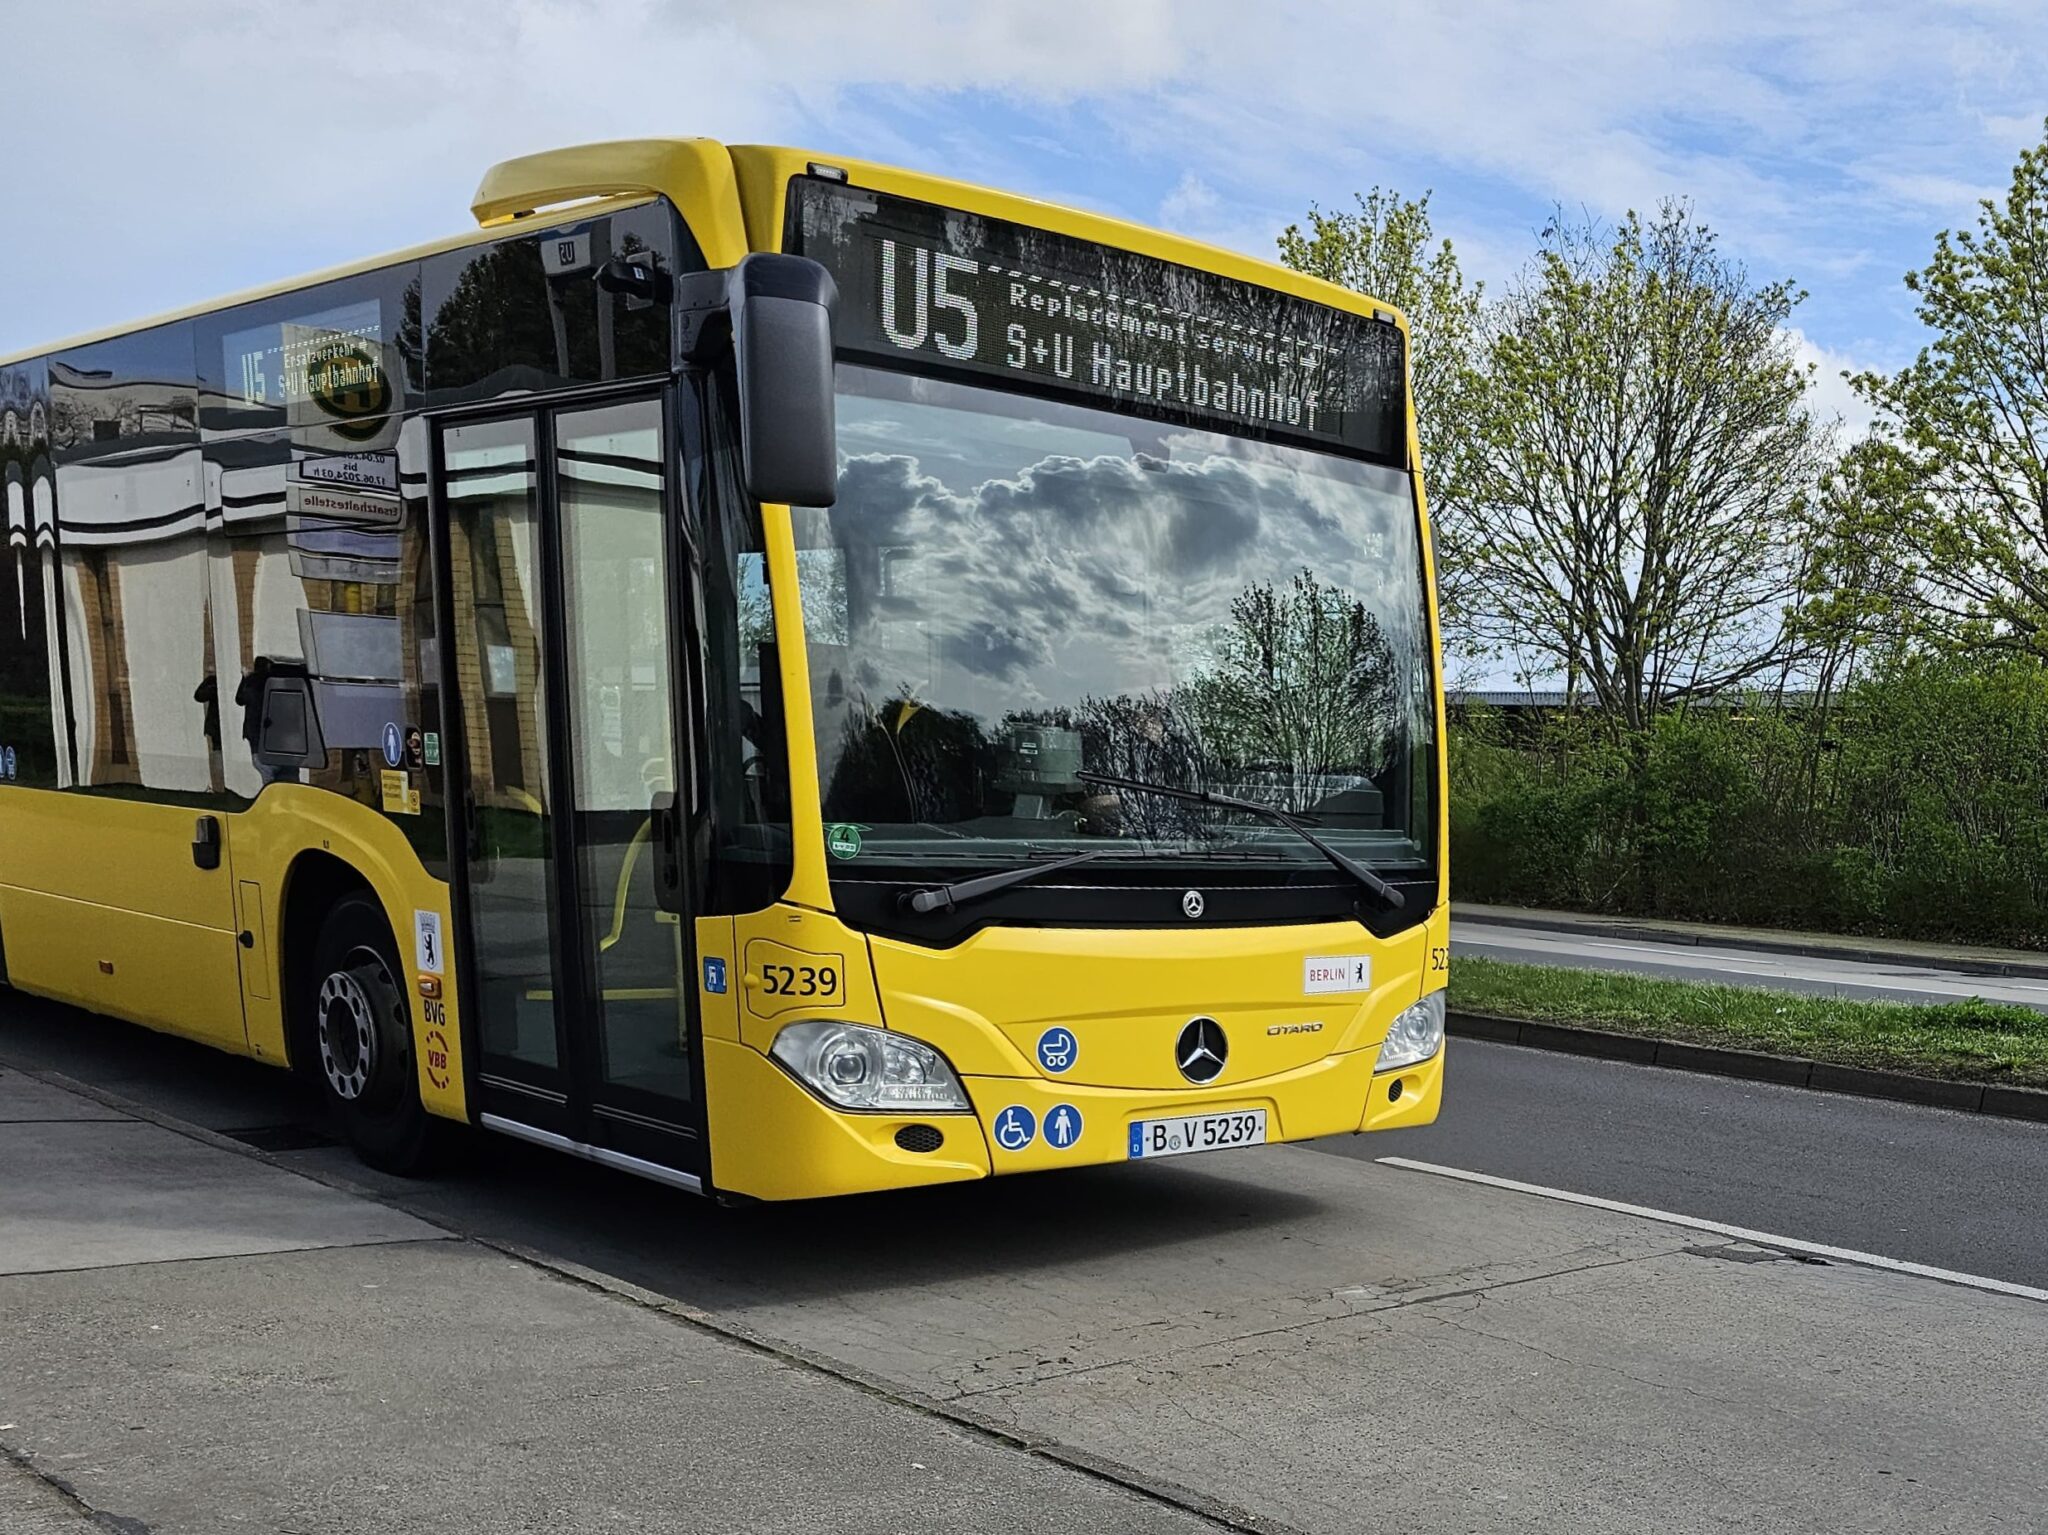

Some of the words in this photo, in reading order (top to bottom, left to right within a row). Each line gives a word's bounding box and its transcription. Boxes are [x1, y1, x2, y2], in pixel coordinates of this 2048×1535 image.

[882, 239, 979, 360] U5
[1009, 282, 1187, 345] Replacement
[1197, 332, 1290, 368] service
[284, 341, 356, 369] Ersatzverkehr
[241, 351, 266, 405] U5
[302, 357, 379, 395] Hauptbahnhof
[1007, 323, 1073, 379] S+U
[1091, 342, 1319, 432] Hauptbahnhof
[763, 965, 838, 996] 5239
[1309, 968, 1345, 982] BERLIN
[424, 999, 446, 1027] BVG
[427, 1049, 447, 1070] VBB
[1153, 1125, 1167, 1151] B
[1184, 1121, 1198, 1148] V
[1203, 1115, 1256, 1146] 5239
